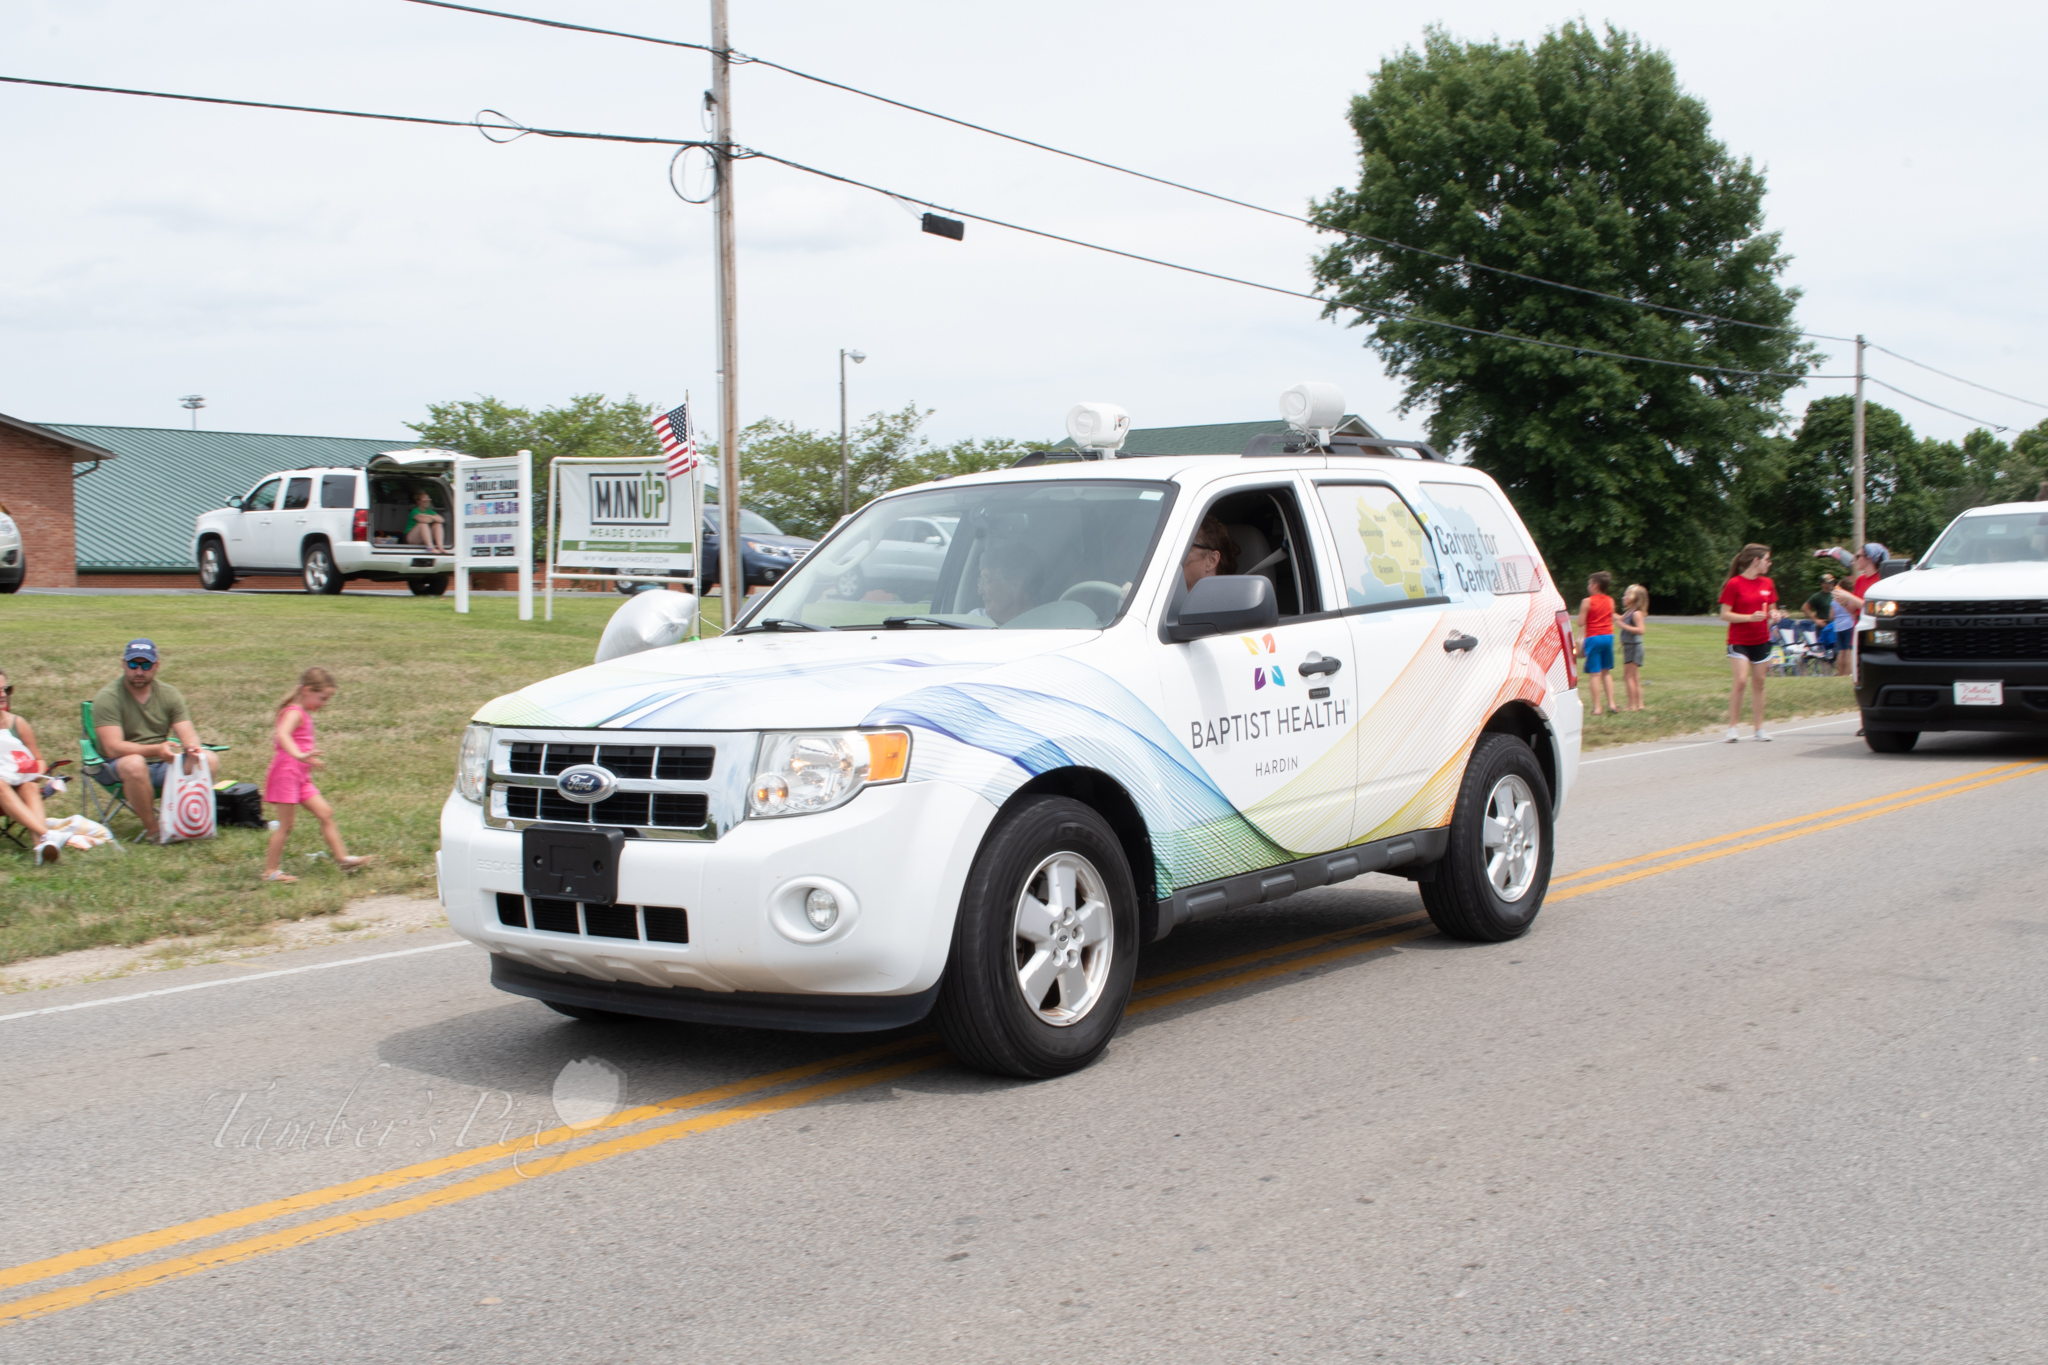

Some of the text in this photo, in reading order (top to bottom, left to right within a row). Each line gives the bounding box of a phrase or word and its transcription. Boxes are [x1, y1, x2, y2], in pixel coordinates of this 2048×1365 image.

[589, 528, 671, 538] MEADE COUNTY
[1434, 525, 1499, 560] Caring for
[1455, 562, 1521, 593] Central KY
[1191, 699, 1347, 749] BAPTIST HEALTH
[1255, 756, 1299, 777] HARDIN
[567, 774, 596, 791] Ford
